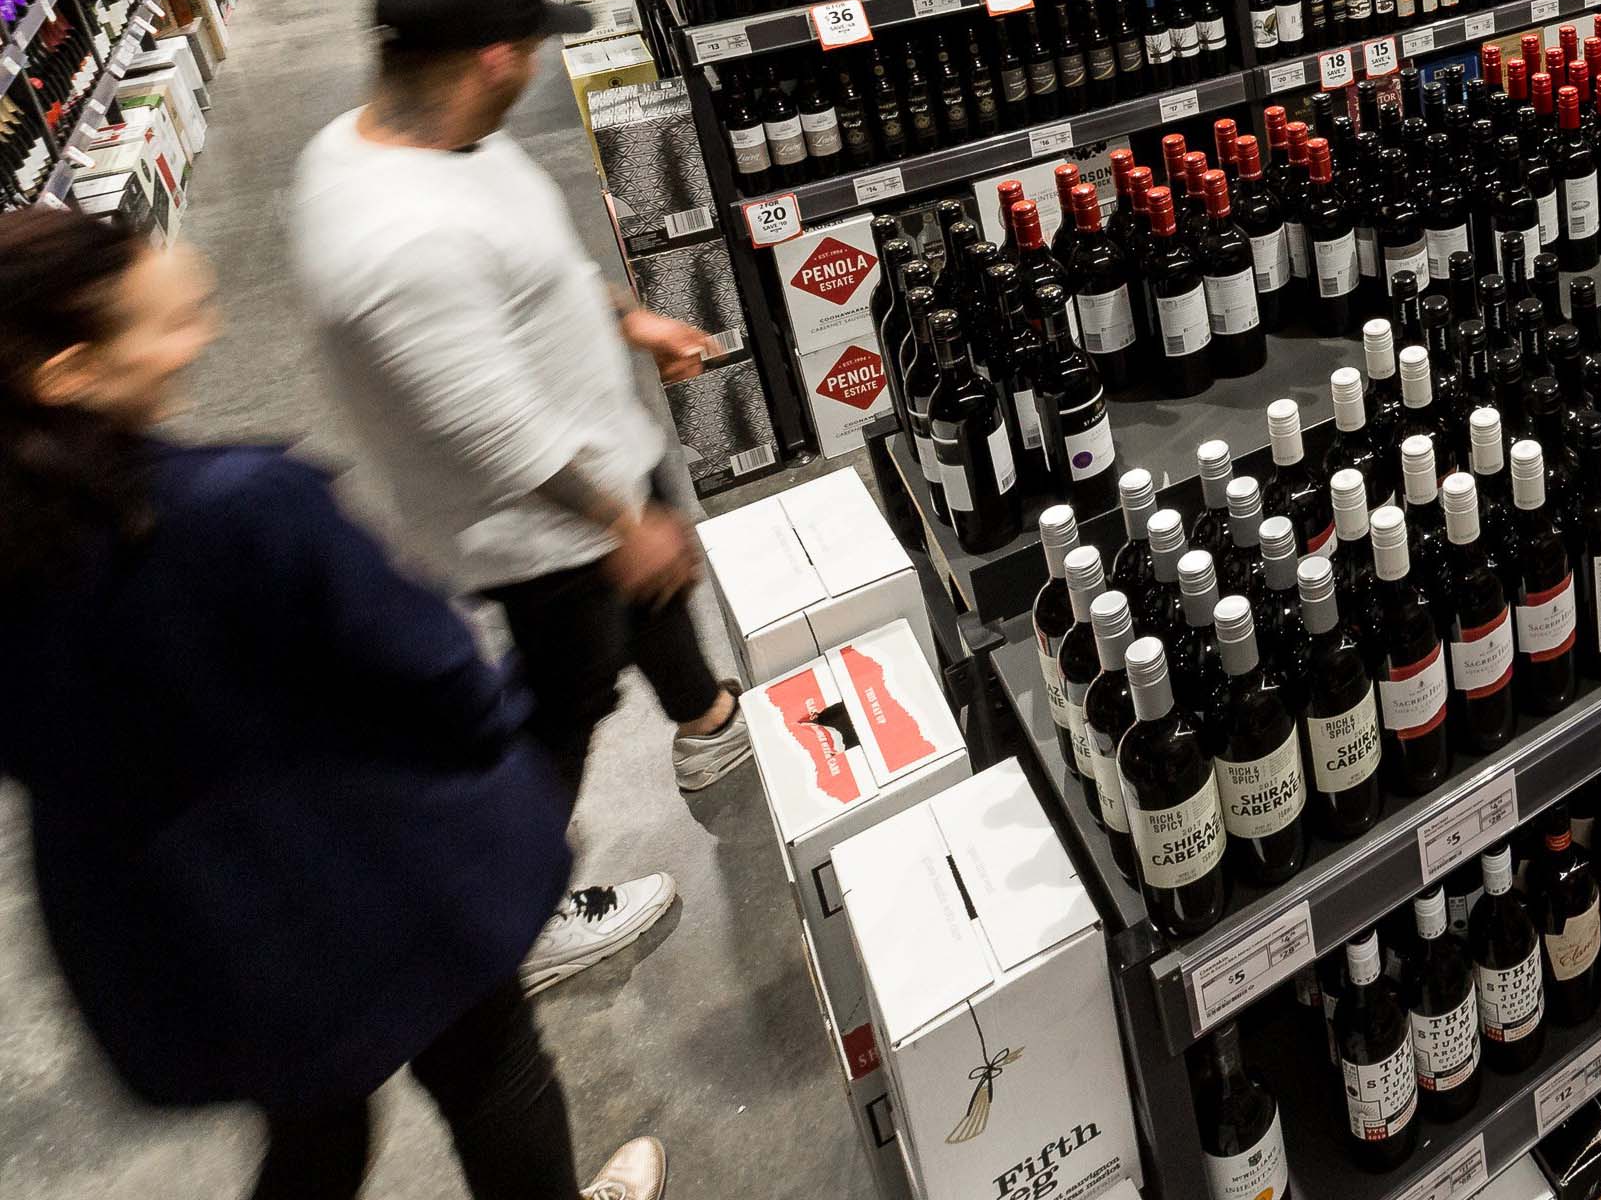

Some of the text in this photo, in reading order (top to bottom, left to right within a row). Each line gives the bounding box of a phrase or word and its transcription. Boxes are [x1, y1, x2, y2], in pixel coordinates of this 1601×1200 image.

[1327, 68, 1341, 77] SAVE
[766, 200, 779, 208] FOR
[757, 206, 787, 224] $20
[762, 223, 777, 231] SAVE
[802, 254, 868, 285] PENOLA
[820, 274, 855, 293] ESTATE
[820, 306, 868, 323] COONAWARRA
[811, 319, 843, 334] CABERNET
[844, 380, 878, 398] ESTATE
[1326, 715, 1355, 731] RICH &
[1329, 726, 1356, 739] SPICY
[1229, 765, 1259, 776] RICH &
[1232, 773, 1260, 785] SPICY
[1241, 771, 1297, 805] SHIRAZ
[1150, 812, 1182, 825] RICH &
[1153, 821, 1183, 834] SPICY
[1162, 812, 1217, 855] SHIRAZ
[1447, 831, 1461, 846] $5
[1498, 955, 1536, 981] THE
[1228, 969, 1245, 985] $5
[1429, 999, 1469, 1029] THE
[993, 1122, 1102, 1199] Fifth
[1065, 1156, 1121, 1196] sauvignon
